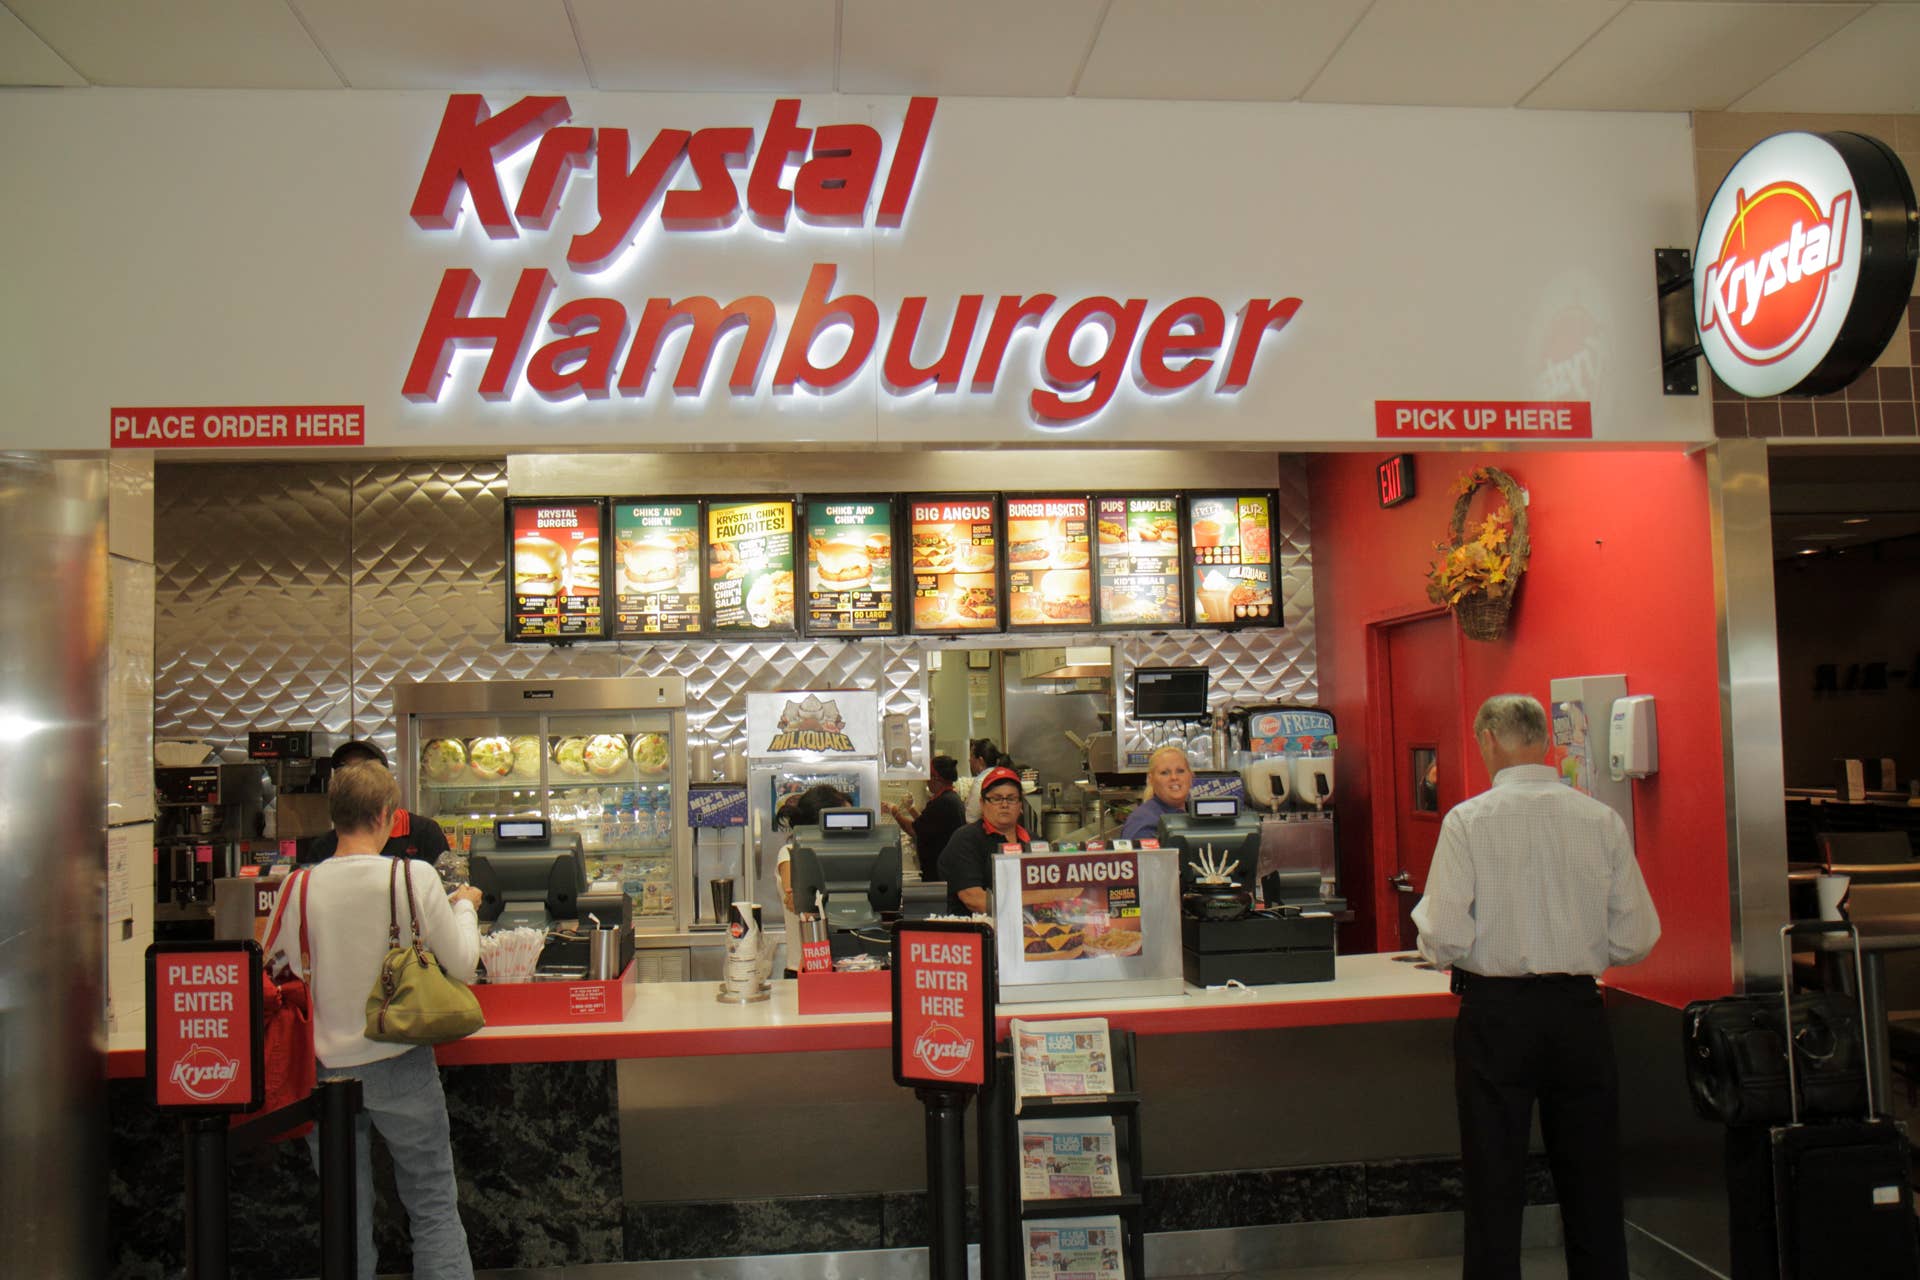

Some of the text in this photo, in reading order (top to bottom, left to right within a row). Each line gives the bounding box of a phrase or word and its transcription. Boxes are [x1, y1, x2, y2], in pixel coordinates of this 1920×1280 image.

[409, 94, 938, 275] Krystal
[1704, 200, 1847, 327] Krystal
[401, 263, 1303, 428] Hamburger
[114, 413, 361, 440] PLACE ORDER HERE
[1395, 408, 1572, 431] PICK UP HERE
[1379, 457, 1401, 504] EXIT
[537, 509, 577, 519] KRYSTAL
[663, 508, 682, 517] AND
[716, 513, 752, 526] KRYSTAL
[756, 507, 785, 519] CHIK'N
[856, 506, 874, 515] AND
[915, 506, 990, 521] BIG ANGUS
[1009, 503, 1085, 517] BURGER BASKETS
[1101, 501, 1124, 513] PUPS
[1130, 501, 1172, 513] SAMPLER
[537, 518, 578, 528] BURGERS
[716, 517, 785, 539] FAVORITES!
[713, 578, 742, 592] CRISPY
[715, 597, 741, 609] SALAD
[865, 611, 887, 619] LARGE
[1282, 713, 1331, 734] FREEZE
[770, 731, 851, 751] MILKQUAKE
[1026, 861, 1135, 885] BIG ANGUS
[803, 945, 830, 958] TRASH
[911, 944, 972, 965] PLEASE
[807, 959, 829, 970] ONLY
[169, 965, 238, 985] PLEASE
[915, 970, 968, 991] ENTER
[174, 992, 233, 1012] ENTER
[921, 996, 964, 1017] HERE
[180, 1018, 228, 1039] HERE
[1055, 1035, 1073, 1043] USA
[916, 1039, 971, 1061] Krystal
[173, 1062, 235, 1086] Krystal
